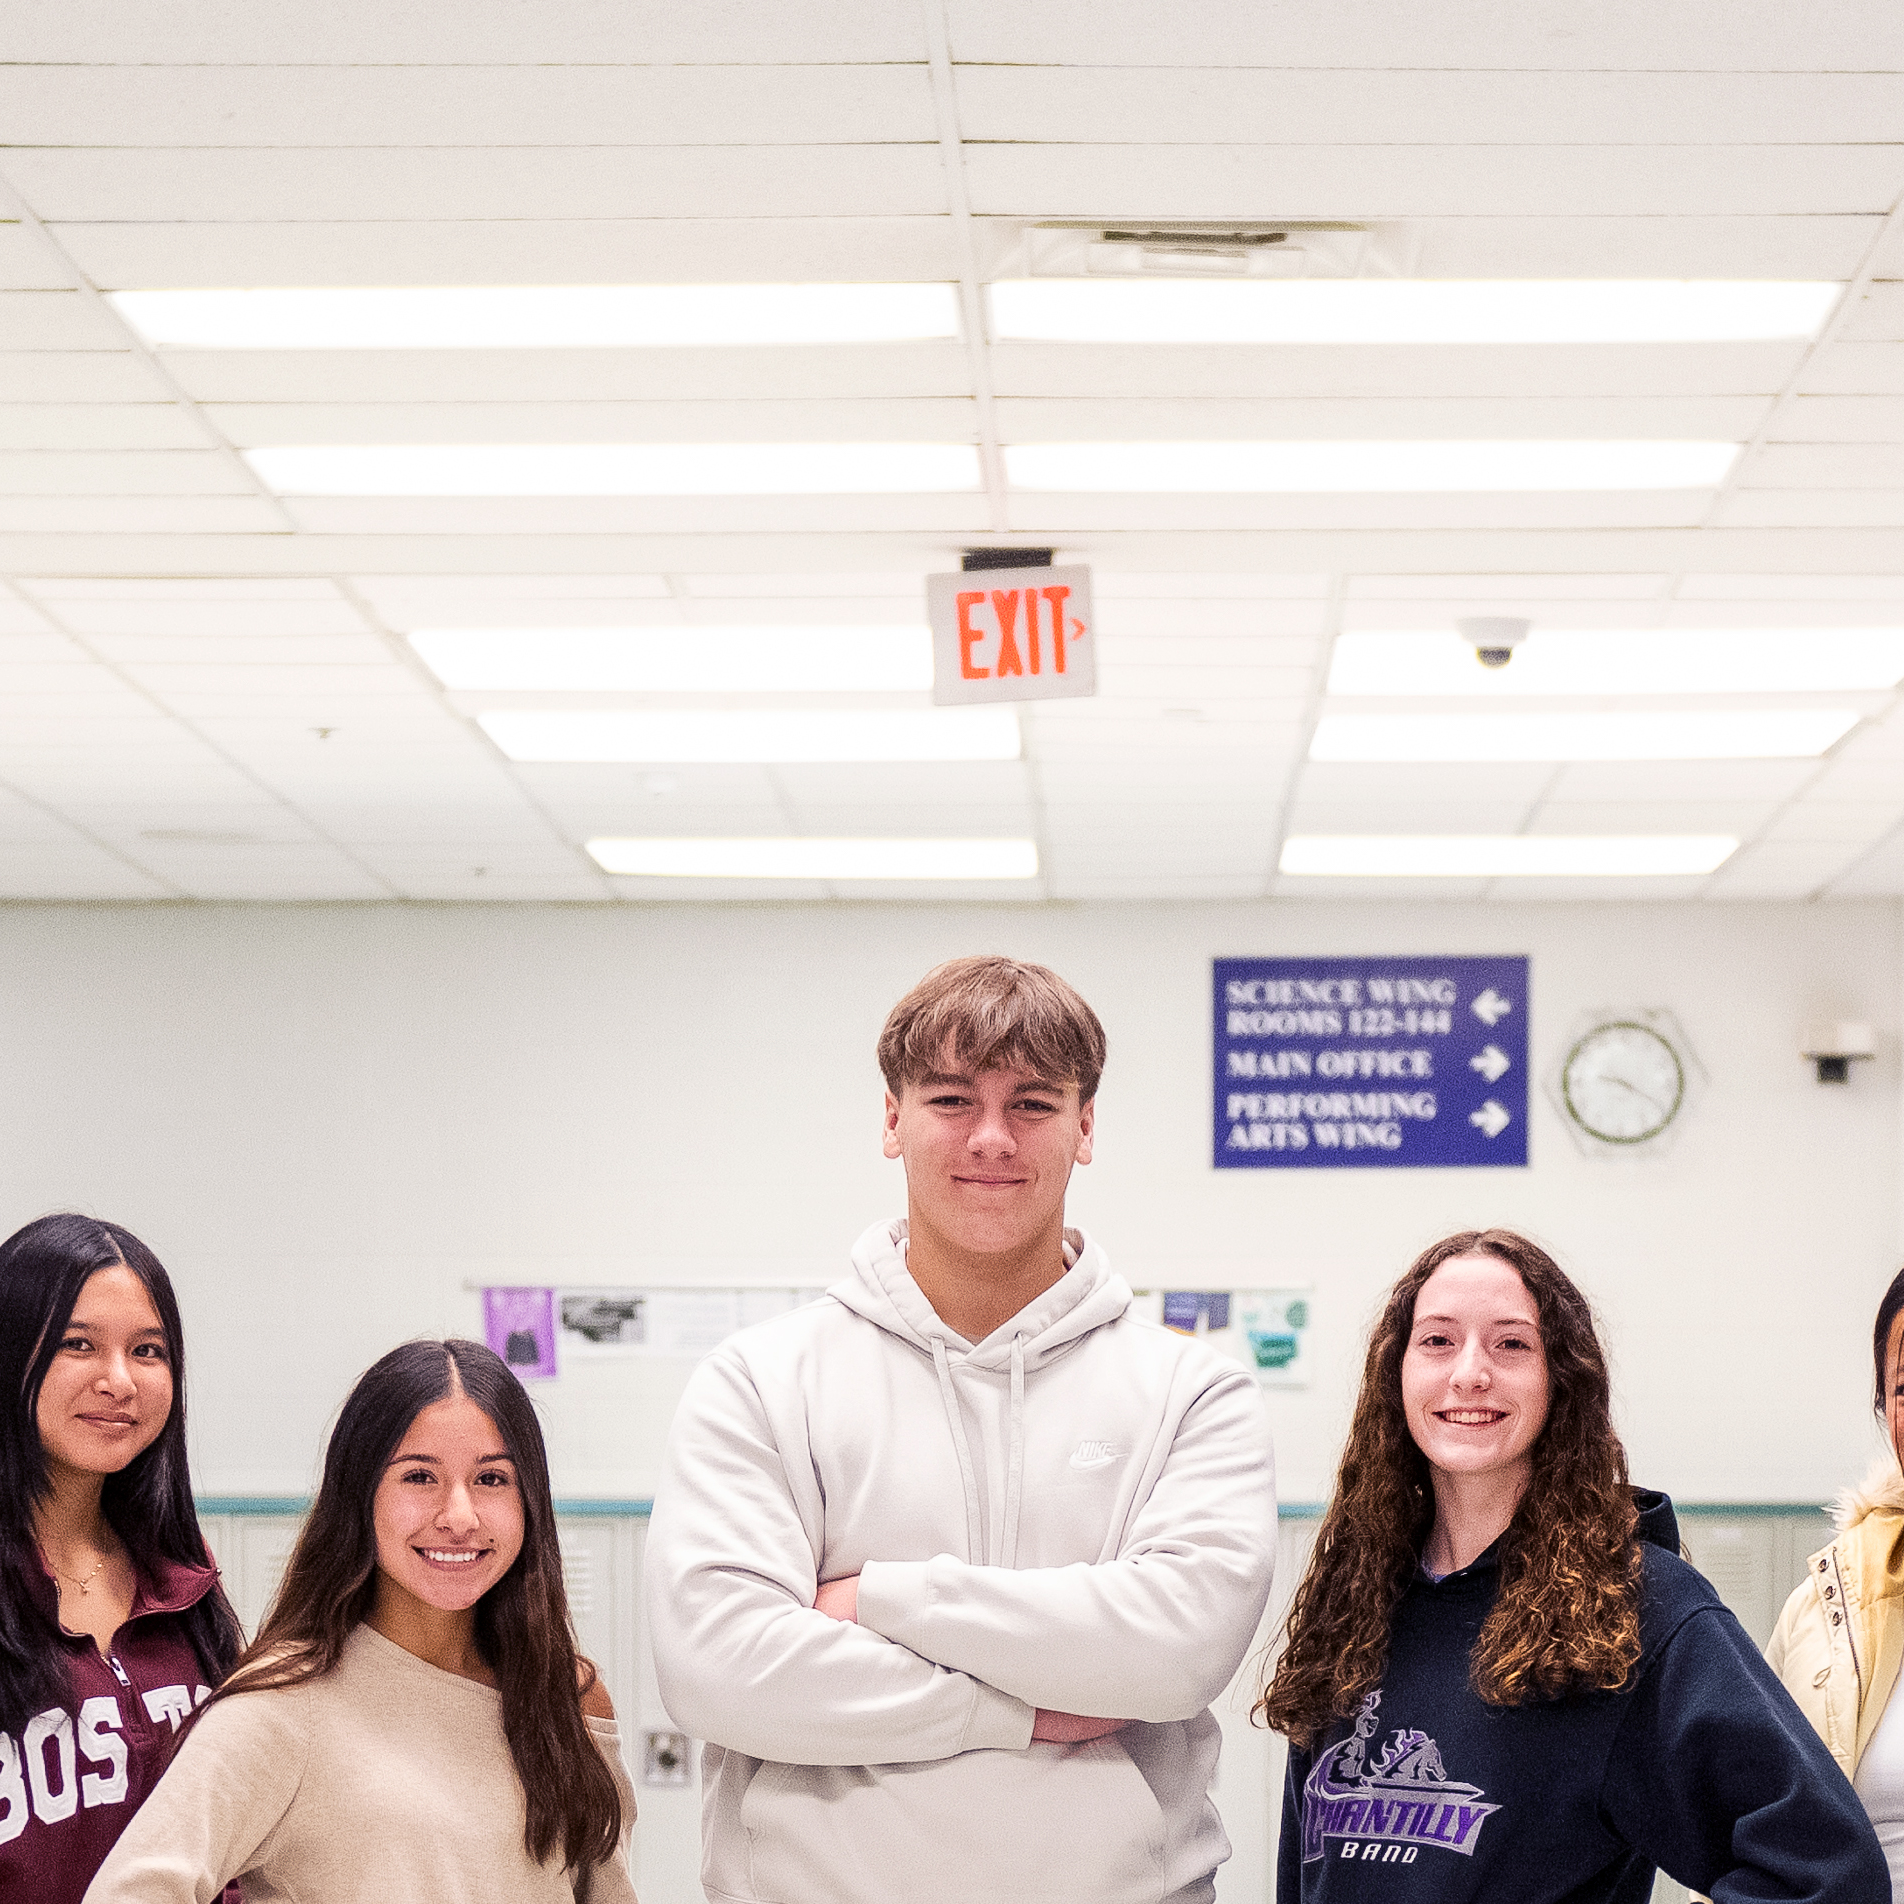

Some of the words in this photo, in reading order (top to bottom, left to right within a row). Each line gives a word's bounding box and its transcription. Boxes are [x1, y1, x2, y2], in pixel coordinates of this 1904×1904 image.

[955, 586, 1071, 679] EXIT
[1226, 979, 1361, 1005] SCIENCE
[1367, 979, 1457, 1005] WING
[1226, 1009, 1343, 1036] ROOMS
[1226, 1051, 1312, 1079] MAIN
[1315, 1051, 1434, 1079] OFFICE
[1226, 1091, 1437, 1121] PERFORMING
[1226, 1122, 1310, 1151] ARTS
[1313, 1122, 1403, 1150] WING
[1076, 1440, 1114, 1461] NIKE
[1340, 1841, 1419, 1864] BAND
